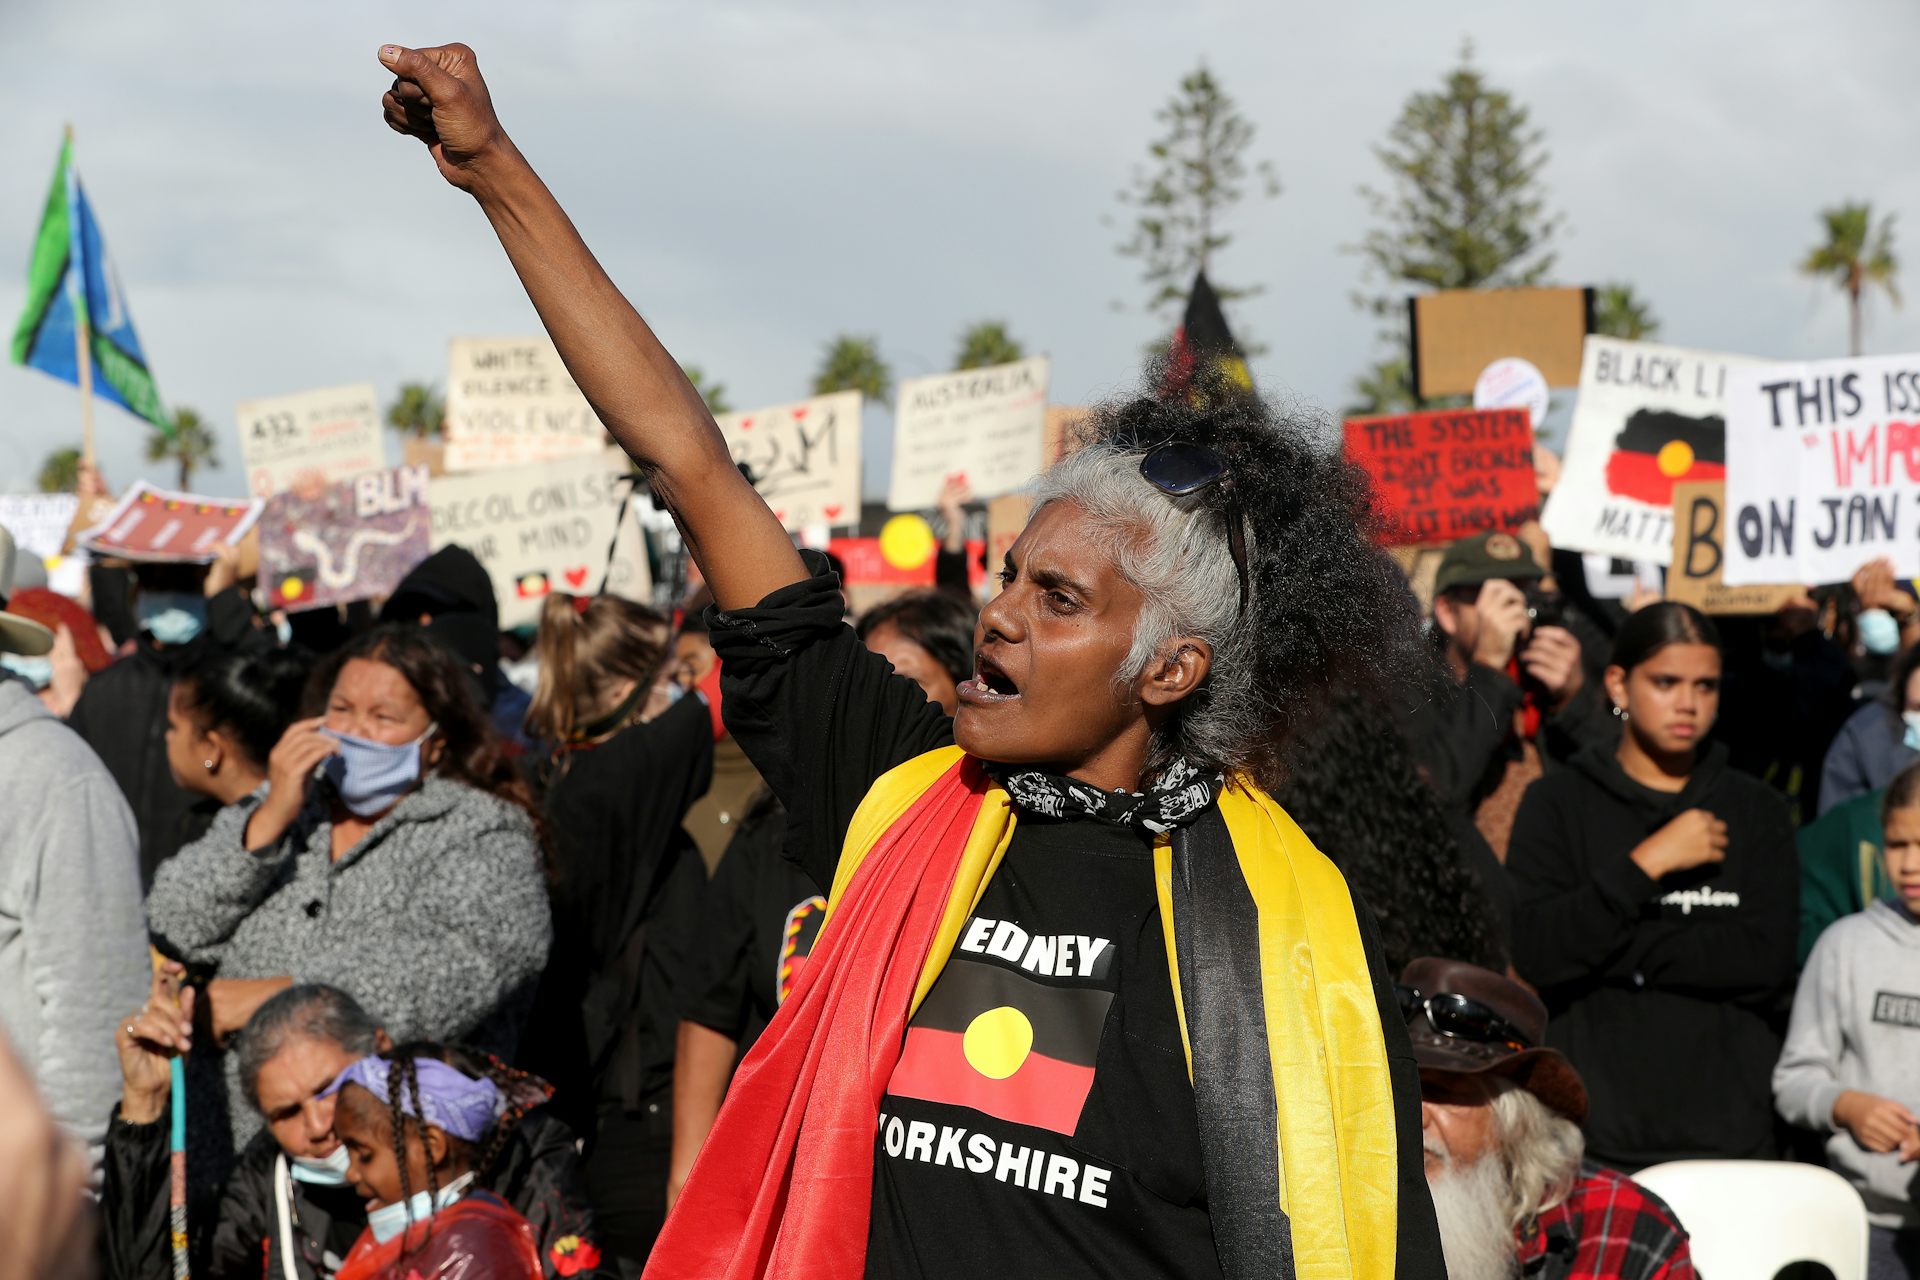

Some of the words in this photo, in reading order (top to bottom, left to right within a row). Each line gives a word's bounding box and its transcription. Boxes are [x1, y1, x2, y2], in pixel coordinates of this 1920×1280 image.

[1596, 349, 1682, 391] BLACK
[1761, 373, 1863, 427] THIS
[1364, 419, 1414, 450] THE
[1429, 411, 1525, 443] SYSTEM
[355, 463, 429, 516] BLM
[431, 472, 618, 533] DECOLONISE
[519, 516, 593, 557] MIND
[1596, 505, 1673, 547] MATT
[1738, 498, 1795, 559] ON
[1813, 493, 1898, 549] JAN
[960, 916, 1111, 977] EDNEY
